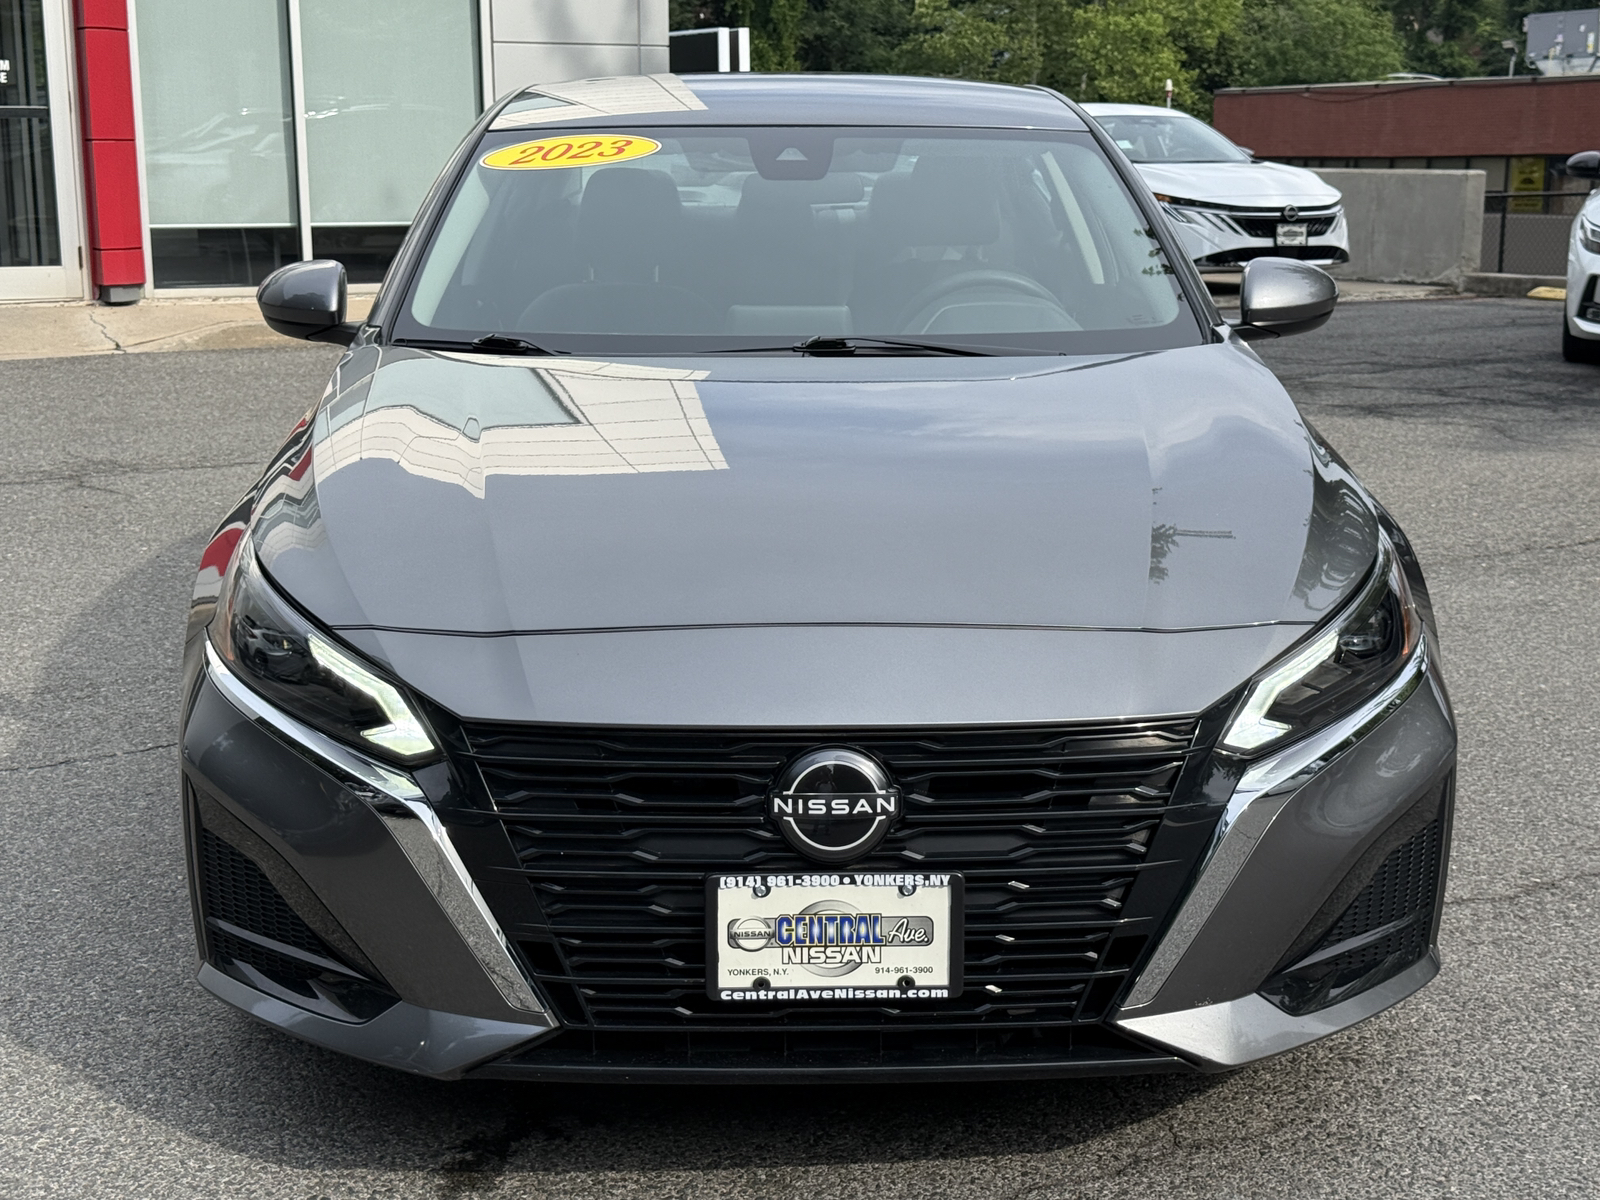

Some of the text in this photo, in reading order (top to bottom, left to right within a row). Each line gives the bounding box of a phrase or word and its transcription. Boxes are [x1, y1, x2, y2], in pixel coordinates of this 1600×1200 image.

[508, 139, 633, 165] 2023
[773, 797, 895, 815] NISSAN
[767, 876, 839, 888] 961-3900
[733, 930, 771, 938] NISSAN
[776, 913, 929, 947] CENTRAL Ave.
[782, 946, 882, 964] NISSAN
[727, 968, 789, 977] YONKERS, N.Y.
[875, 966, 934, 974] 914-961-3900
